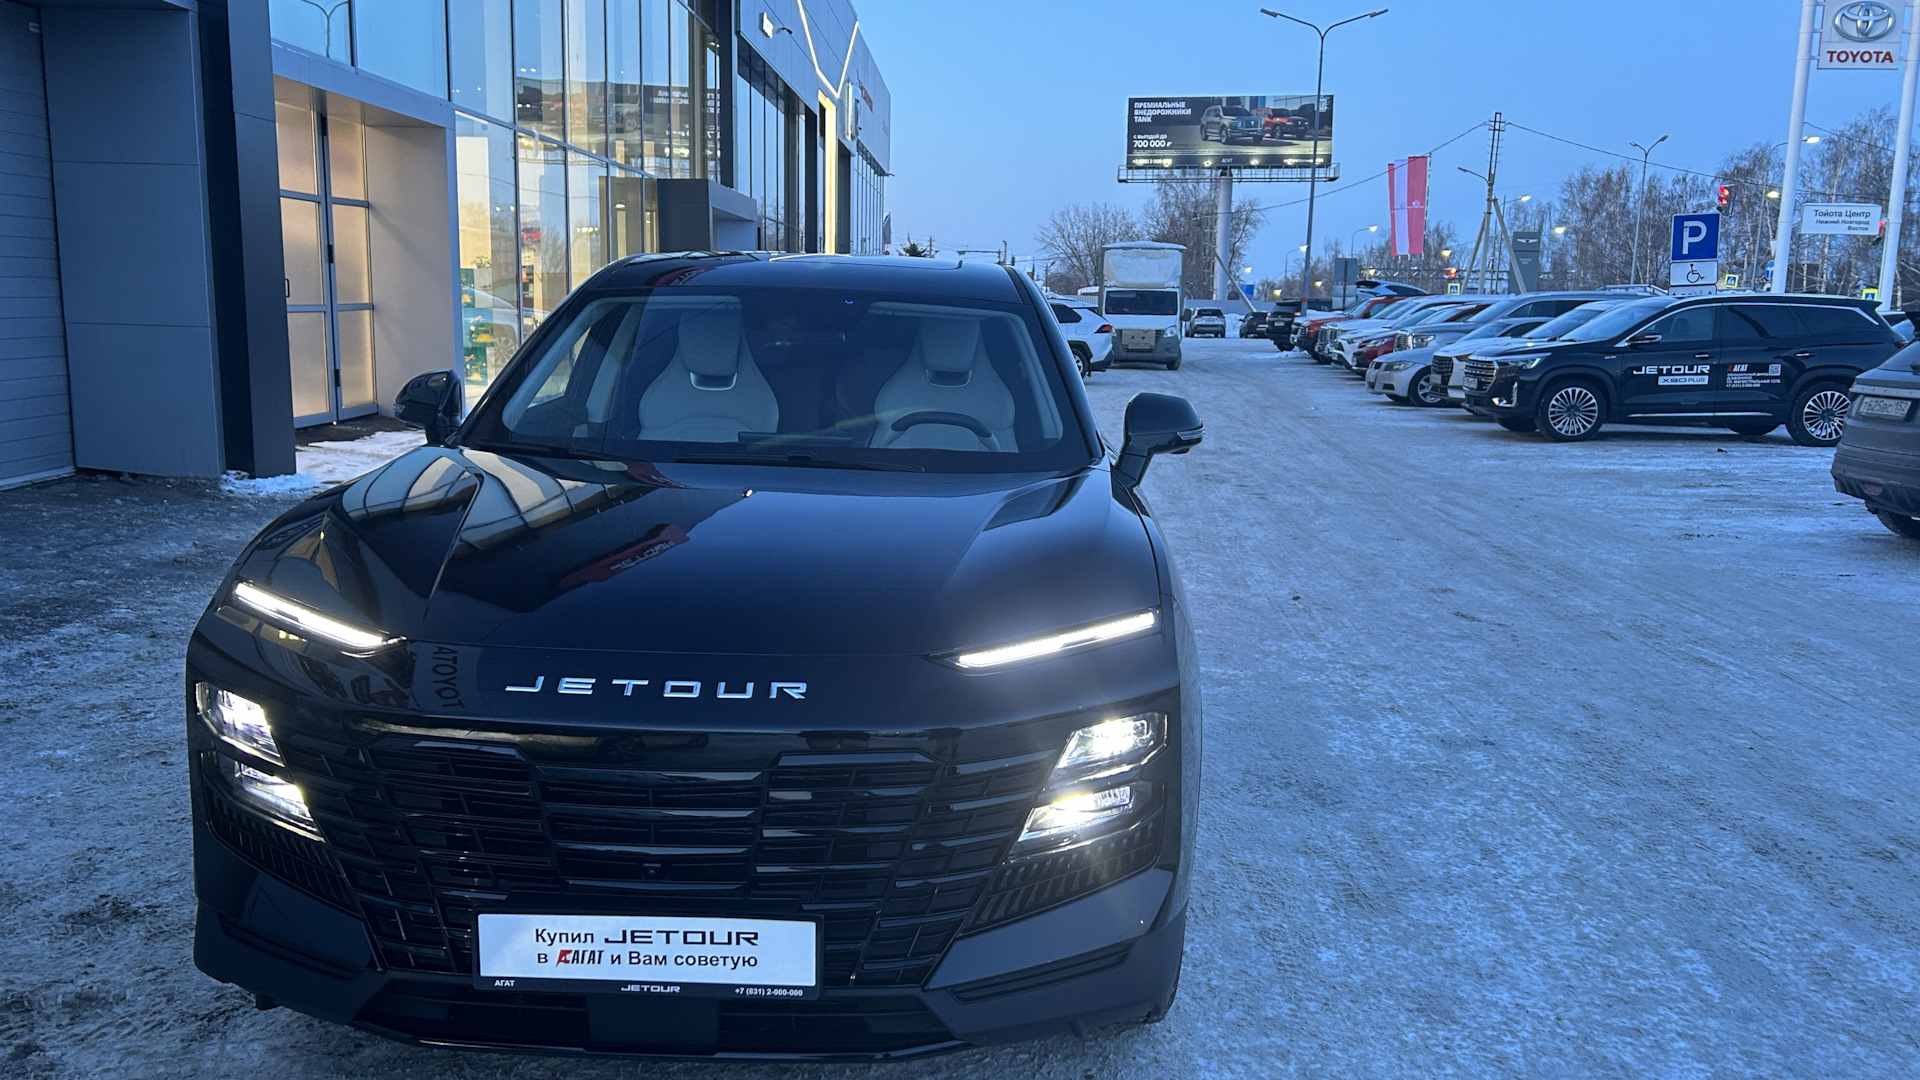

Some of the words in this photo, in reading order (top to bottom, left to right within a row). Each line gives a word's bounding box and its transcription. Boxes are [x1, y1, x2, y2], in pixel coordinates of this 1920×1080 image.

[1826, 50, 1894, 63] TOYOTA
[1814, 209, 1843, 217] Тойота
[1845, 210, 1871, 219] Центр
[1682, 220, 1707, 255] P
[1633, 365, 1711, 374] JETOUR
[1732, 364, 1748, 372] АГАТ
[505, 675, 807, 699] JETOUR
[535, 927, 595, 947] Купил
[604, 929, 759, 946] JETOUR
[537, 952, 549, 964] в
[570, 949, 605, 965] АГАТ
[610, 954, 622, 965] и
[628, 951, 667, 966] Вам
[674, 954, 758, 971] советую
[621, 984, 681, 993] JETOUR
[746, 987, 765, 996] (831)
[766, 988, 803, 997] 2-000-000
